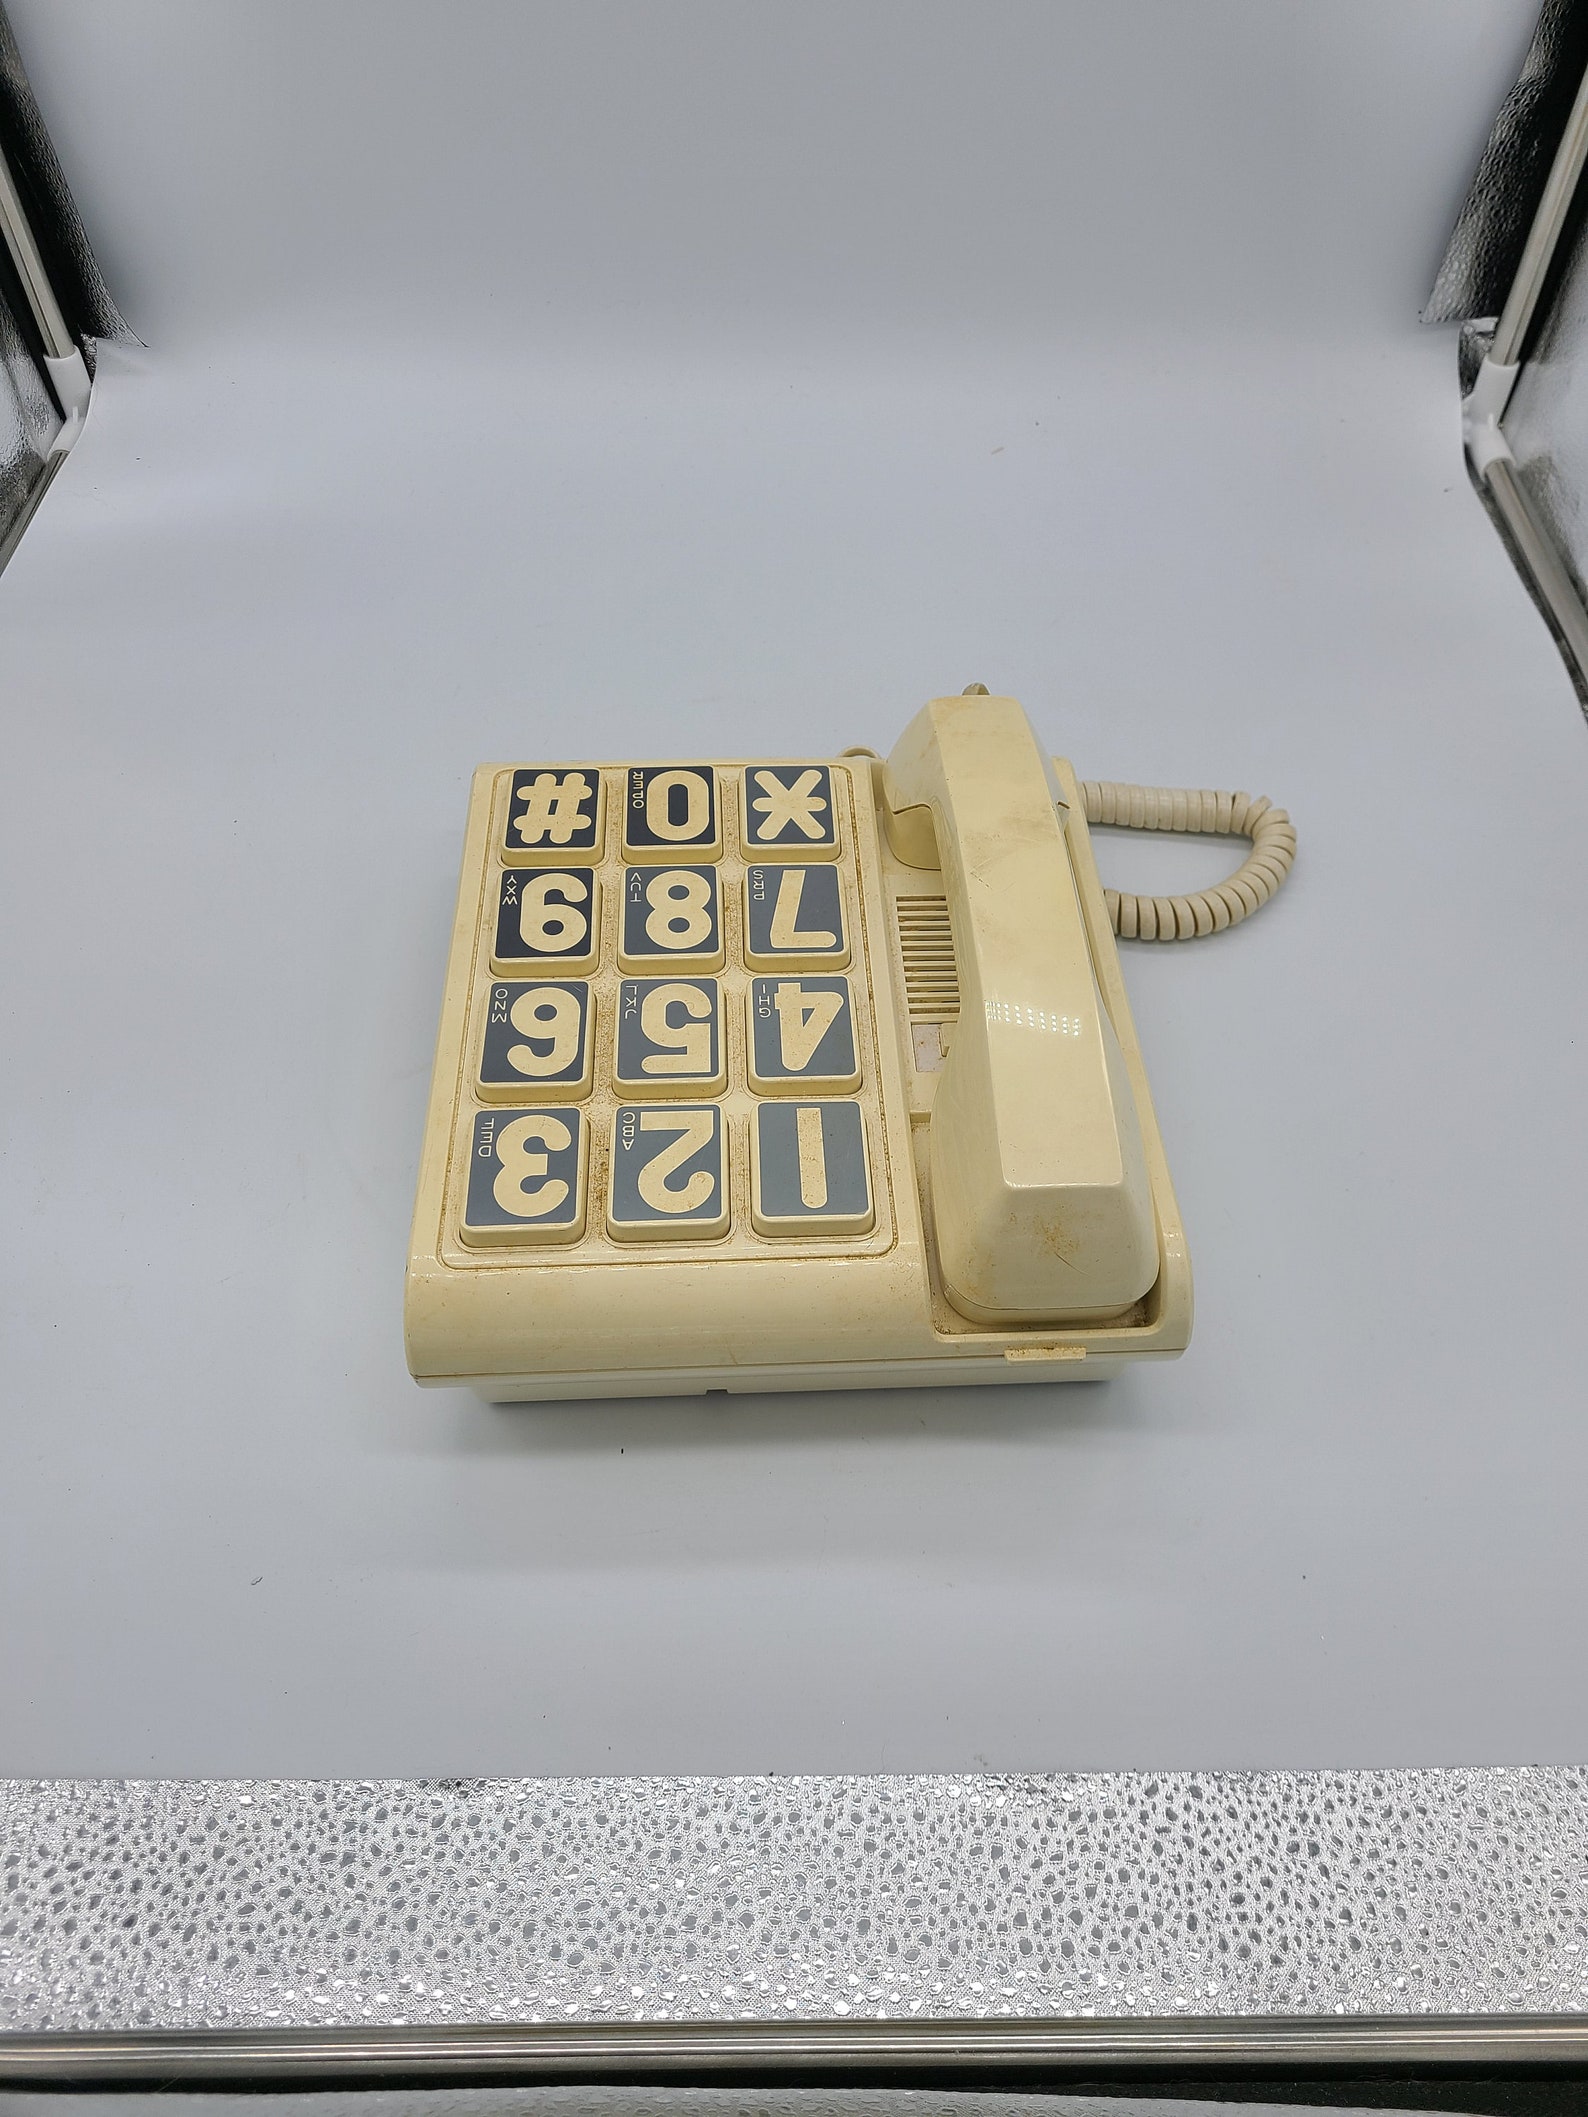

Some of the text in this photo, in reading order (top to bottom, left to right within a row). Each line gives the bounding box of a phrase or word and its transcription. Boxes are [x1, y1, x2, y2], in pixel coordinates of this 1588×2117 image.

[513, 772, 592, 844] #
[632, 771, 644, 809] OPER
[646, 770, 710, 841] 0
[502, 875, 518, 905] WXY
[519, 873, 588, 952] 9
[630, 872, 642, 902] TUV
[645, 870, 712, 949] 8
[753, 869, 765, 900] PRS
[770, 869, 837, 948] 7
[491, 989, 508, 1023] MNO
[507, 987, 581, 1077] 6
[624, 985, 638, 1019] JKL
[640, 983, 712, 1074] 5
[758, 984, 771, 1017] GHI
[774, 983, 844, 1071] 4
[477, 1117, 495, 1158] DEF
[492, 1114, 572, 1217] 3
[621, 1112, 635, 1150] ABC
[637, 1110, 715, 1214] 2
[796, 1107, 827, 1209] 1
